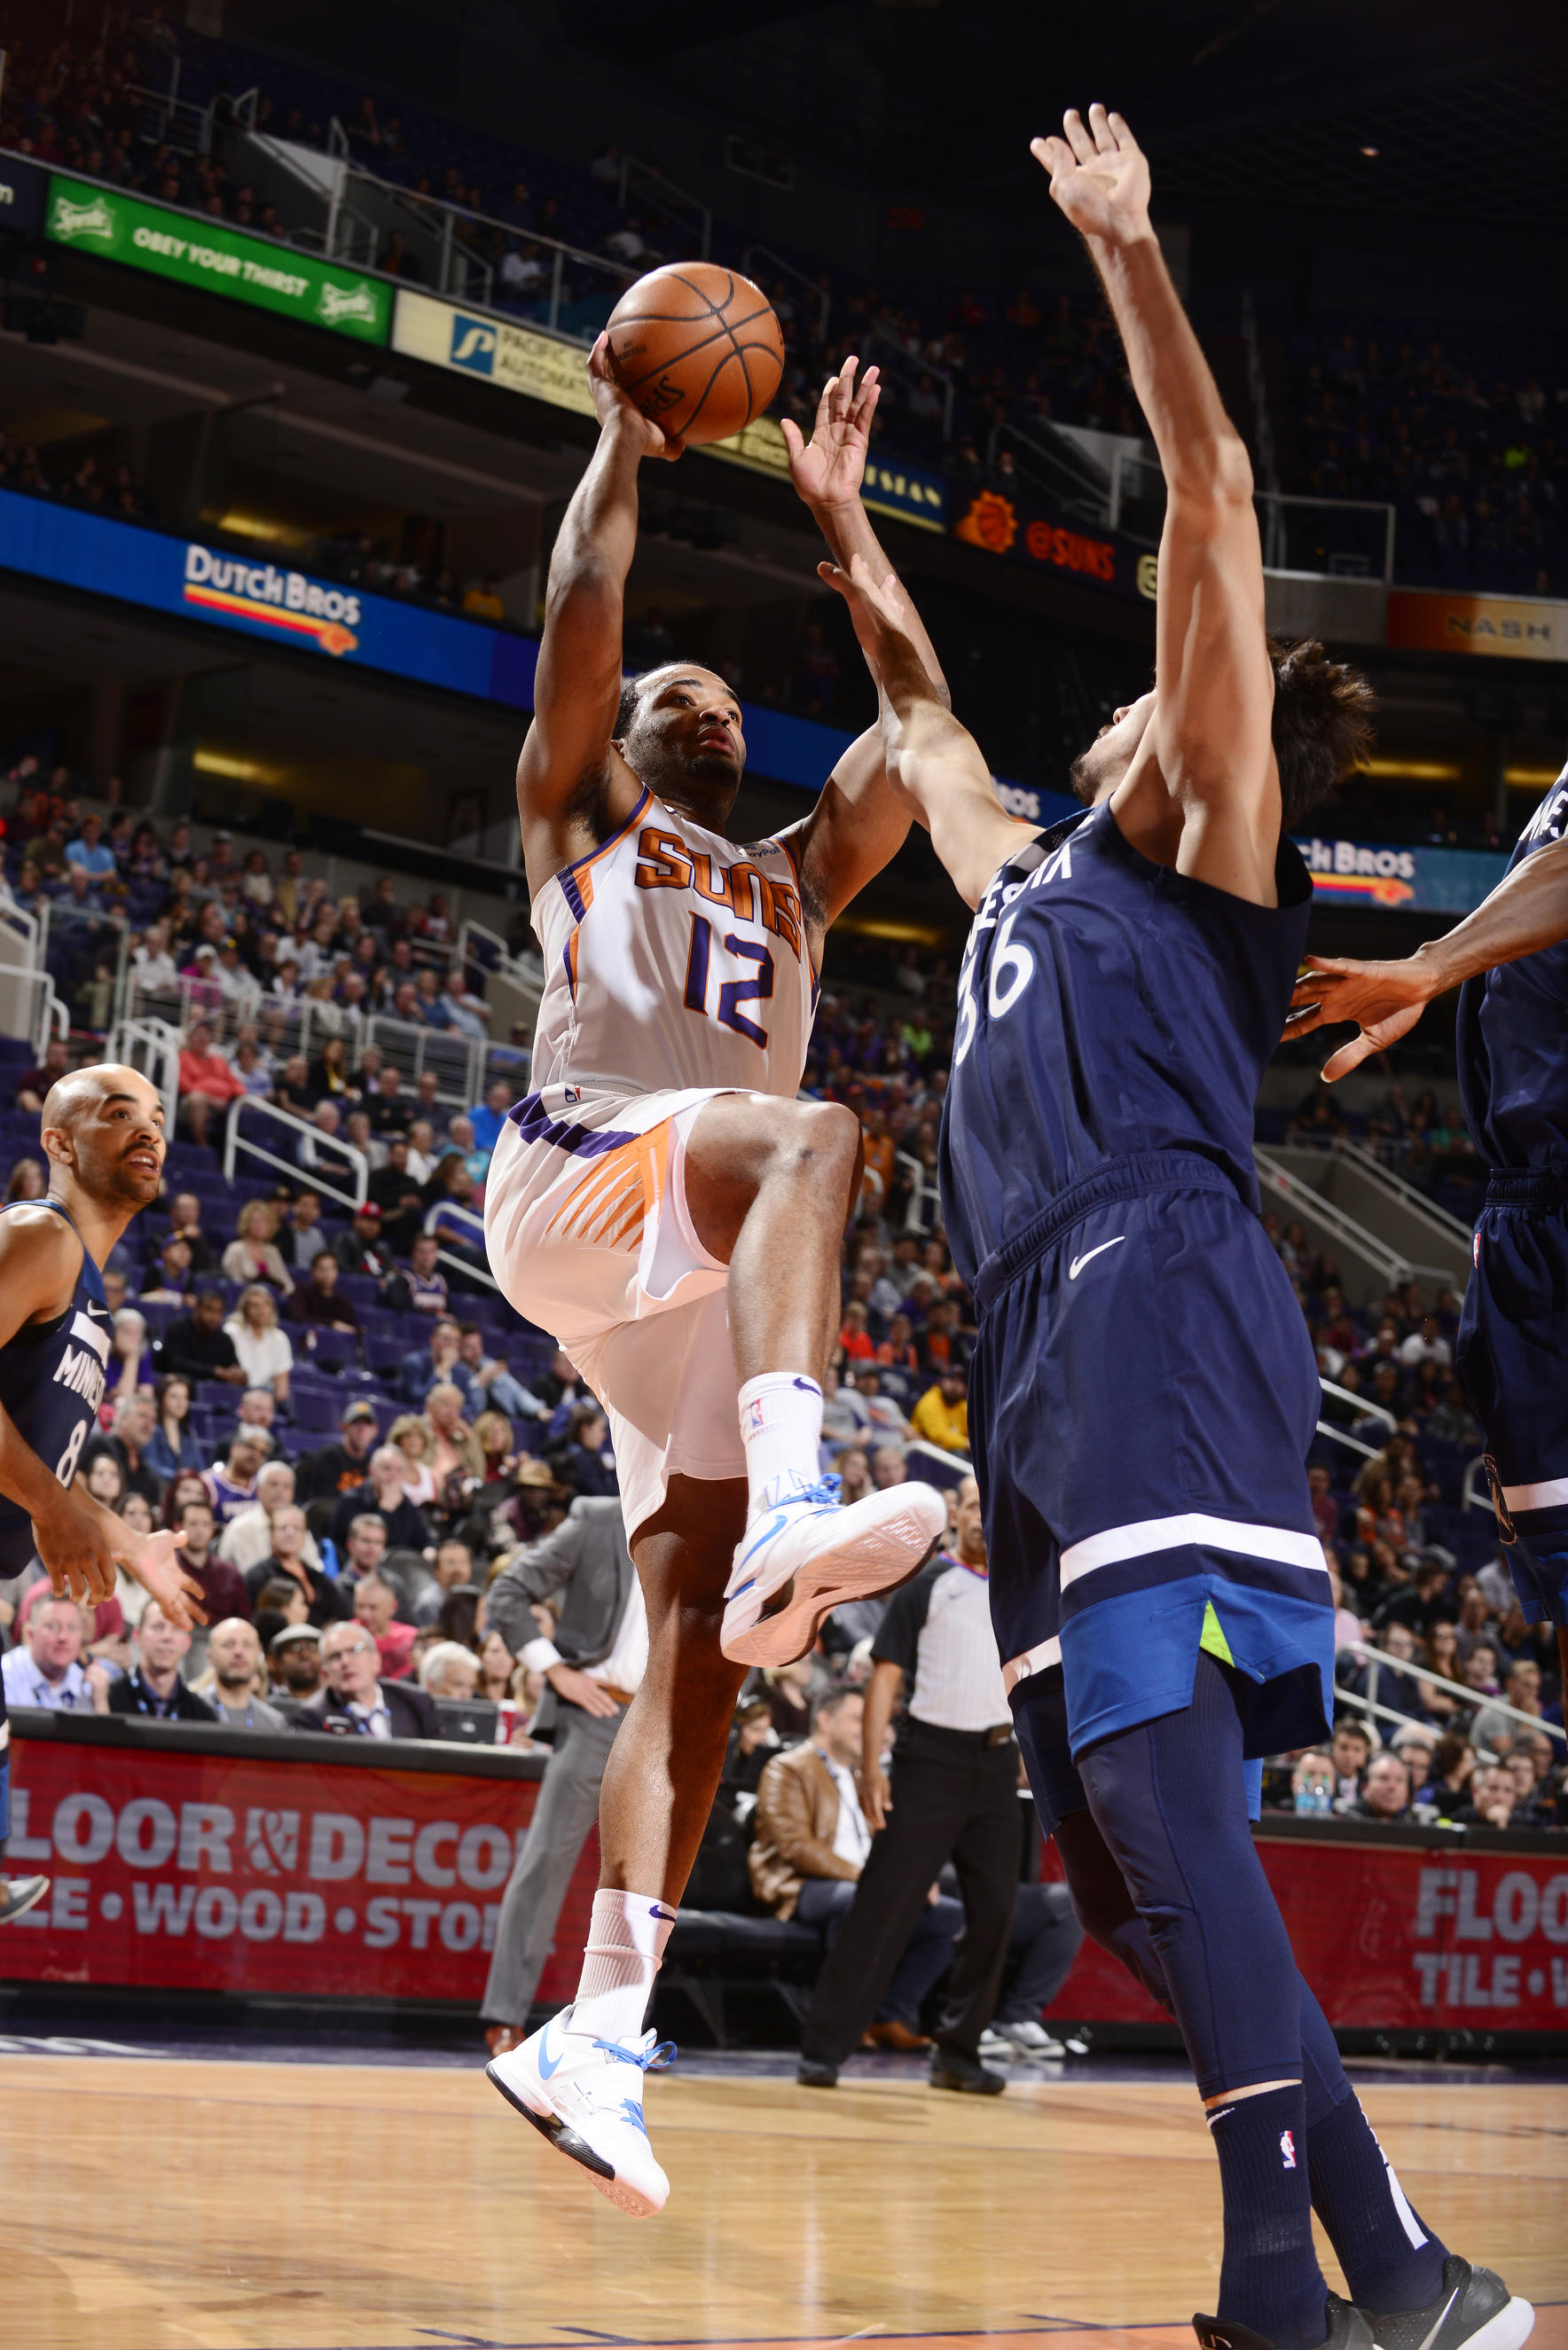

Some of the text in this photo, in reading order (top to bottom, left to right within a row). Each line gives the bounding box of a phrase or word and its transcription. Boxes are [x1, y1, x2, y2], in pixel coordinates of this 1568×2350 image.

[134, 227, 310, 298] OBEY YOUR THIRST
[501, 329, 568, 369] PACIFIC
[1025, 520, 1116, 582] @SUNS
[1447, 615, 1550, 642] NASH
[990, 774, 1041, 820] ROS
[747, 846, 780, 858] ayPal
[635, 826, 802, 964] SUNS
[684, 910, 774, 1051] 12
[55, 1419, 87, 1489] 8
[132, 1882, 326, 1943] WOOD
[364, 1896, 555, 1954] STO
[1413, 1952, 1523, 2009] TILE
